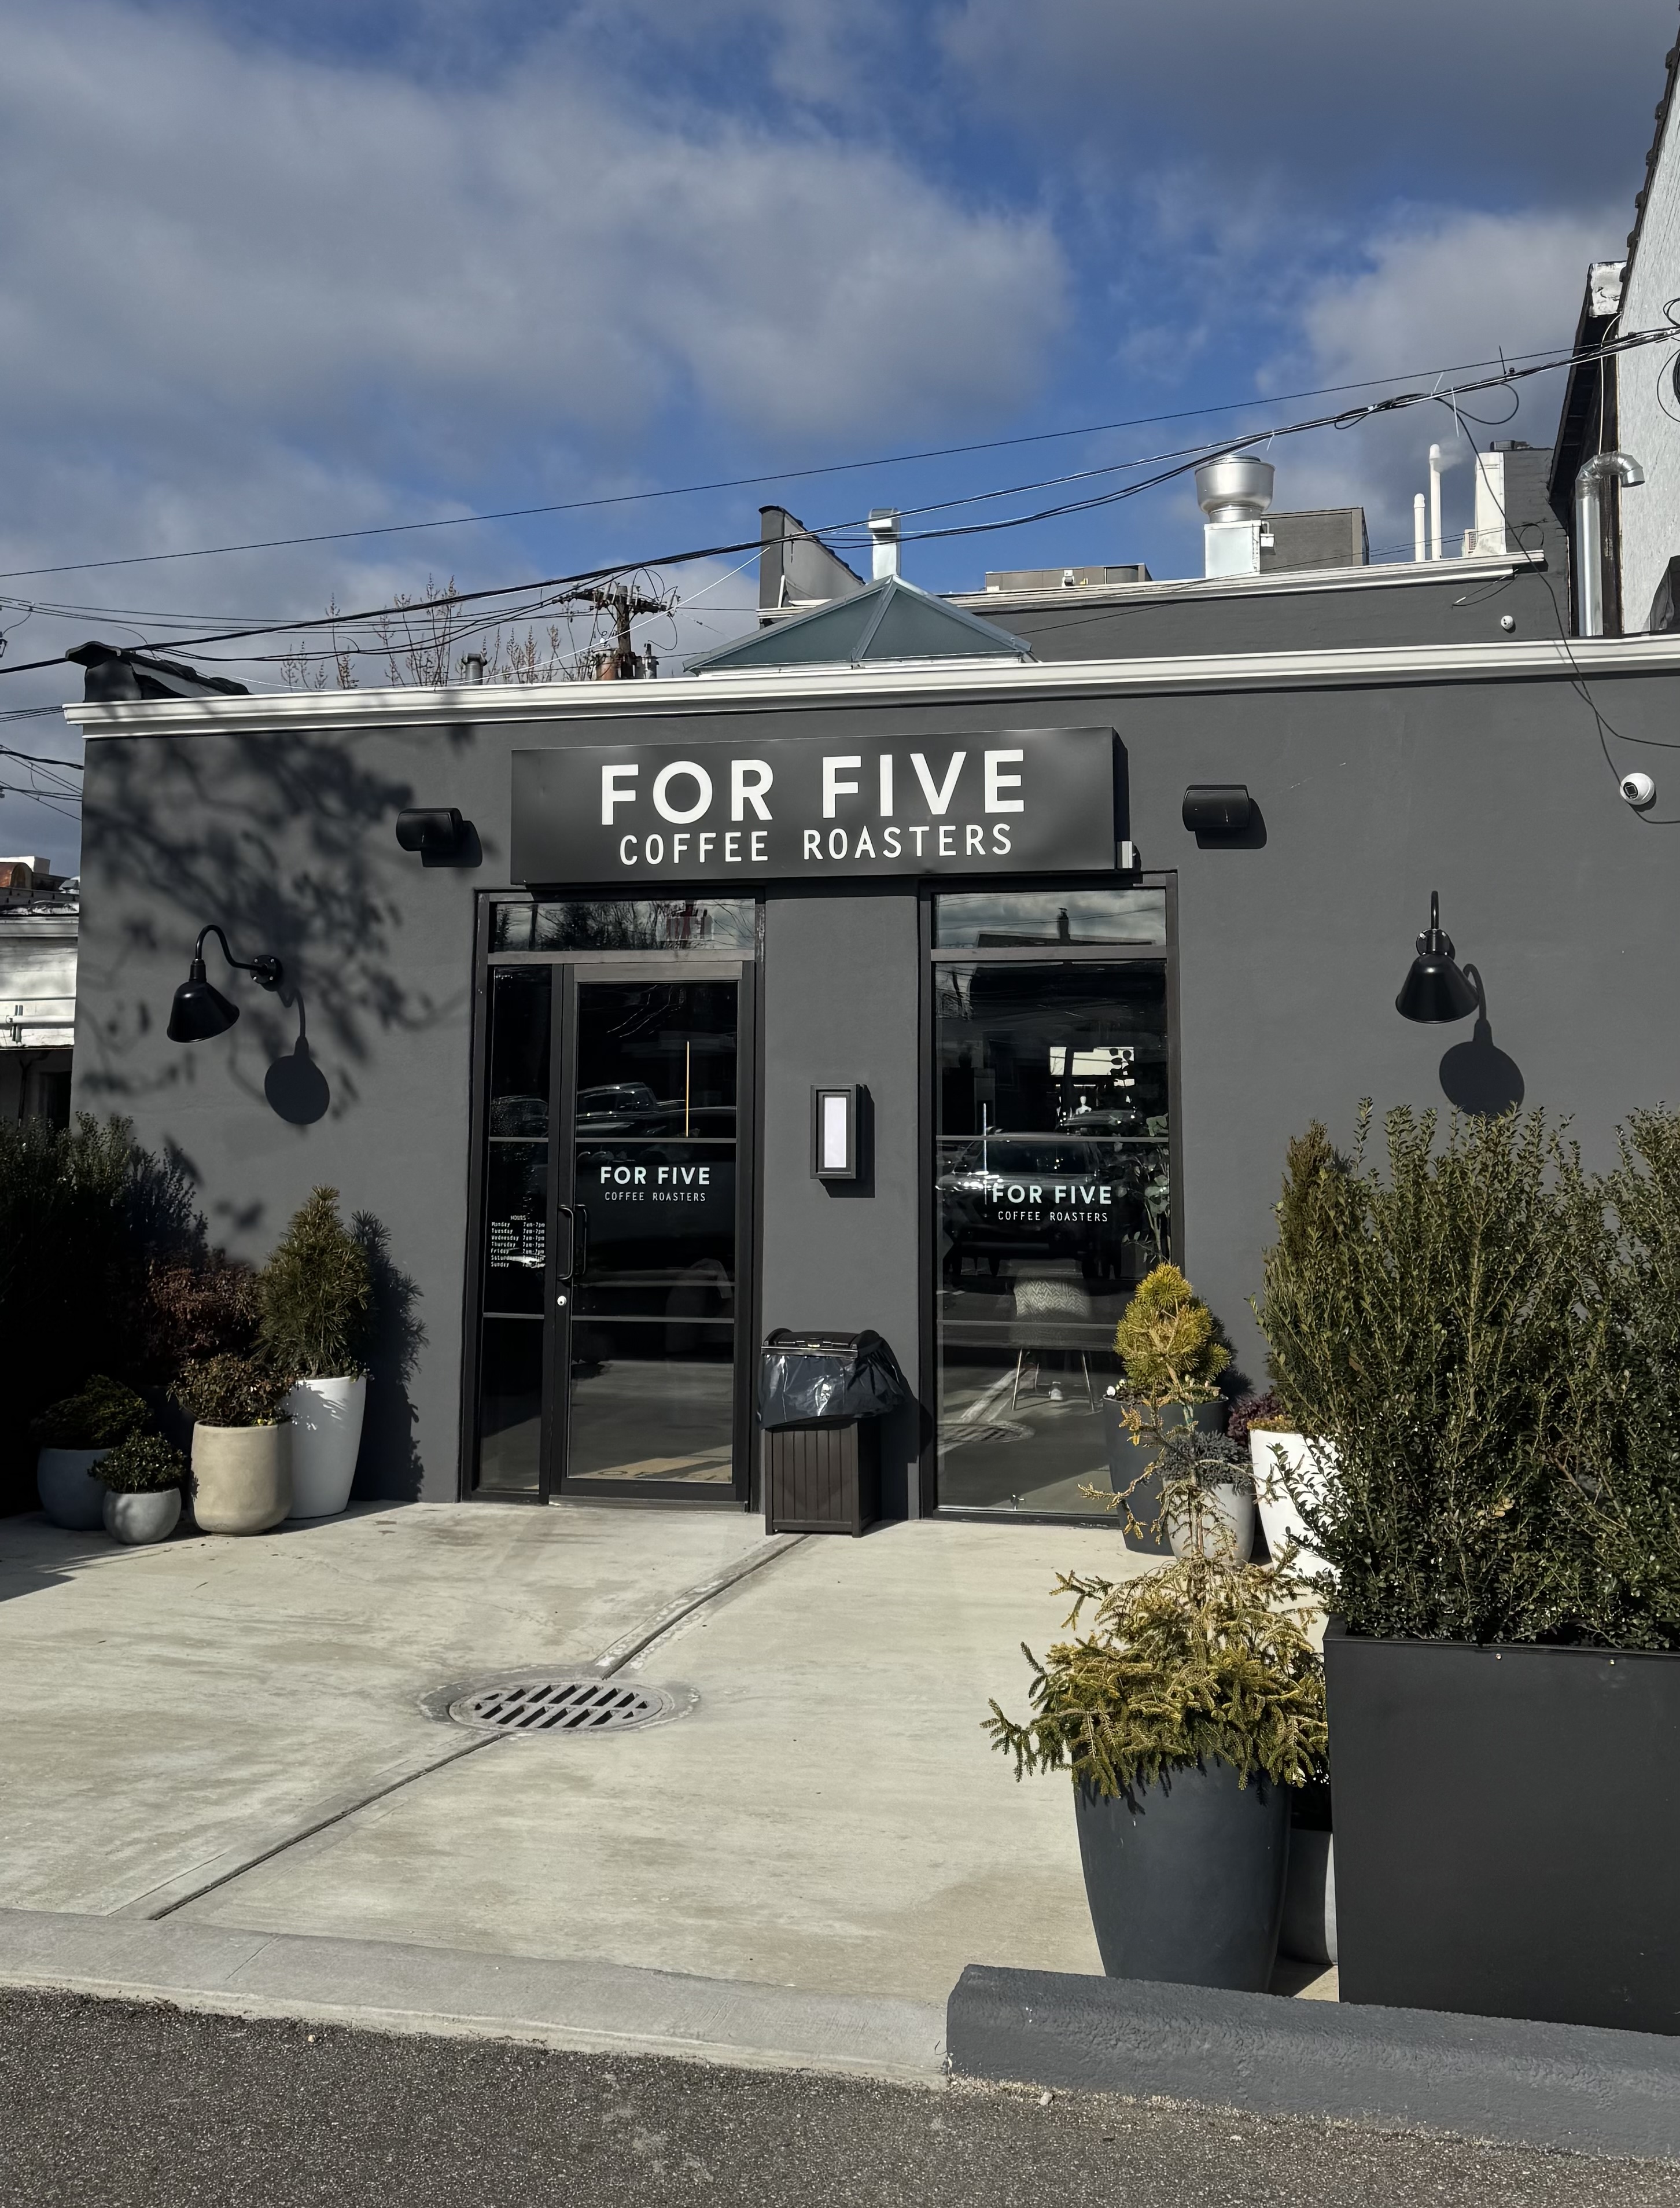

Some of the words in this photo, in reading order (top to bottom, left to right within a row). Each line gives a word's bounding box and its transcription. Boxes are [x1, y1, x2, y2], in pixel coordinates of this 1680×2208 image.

[602, 759, 774, 825] FOR
[823, 749, 1025, 819] FIVE
[620, 830, 769, 866] COFFEE
[803, 823, 1012, 860] ROASTERS
[601, 1167, 646, 1184] FOR
[658, 1167, 709, 1184] FIVE
[605, 1192, 643, 1200] COFFEE
[653, 1193, 705, 1201] ROASTERS
[993, 1185, 1042, 1204] FOR
[1055, 1186, 1111, 1204] FIVE
[999, 1211, 1040, 1220] COFFEE
[1050, 1212, 1107, 1221] ROASTERS
